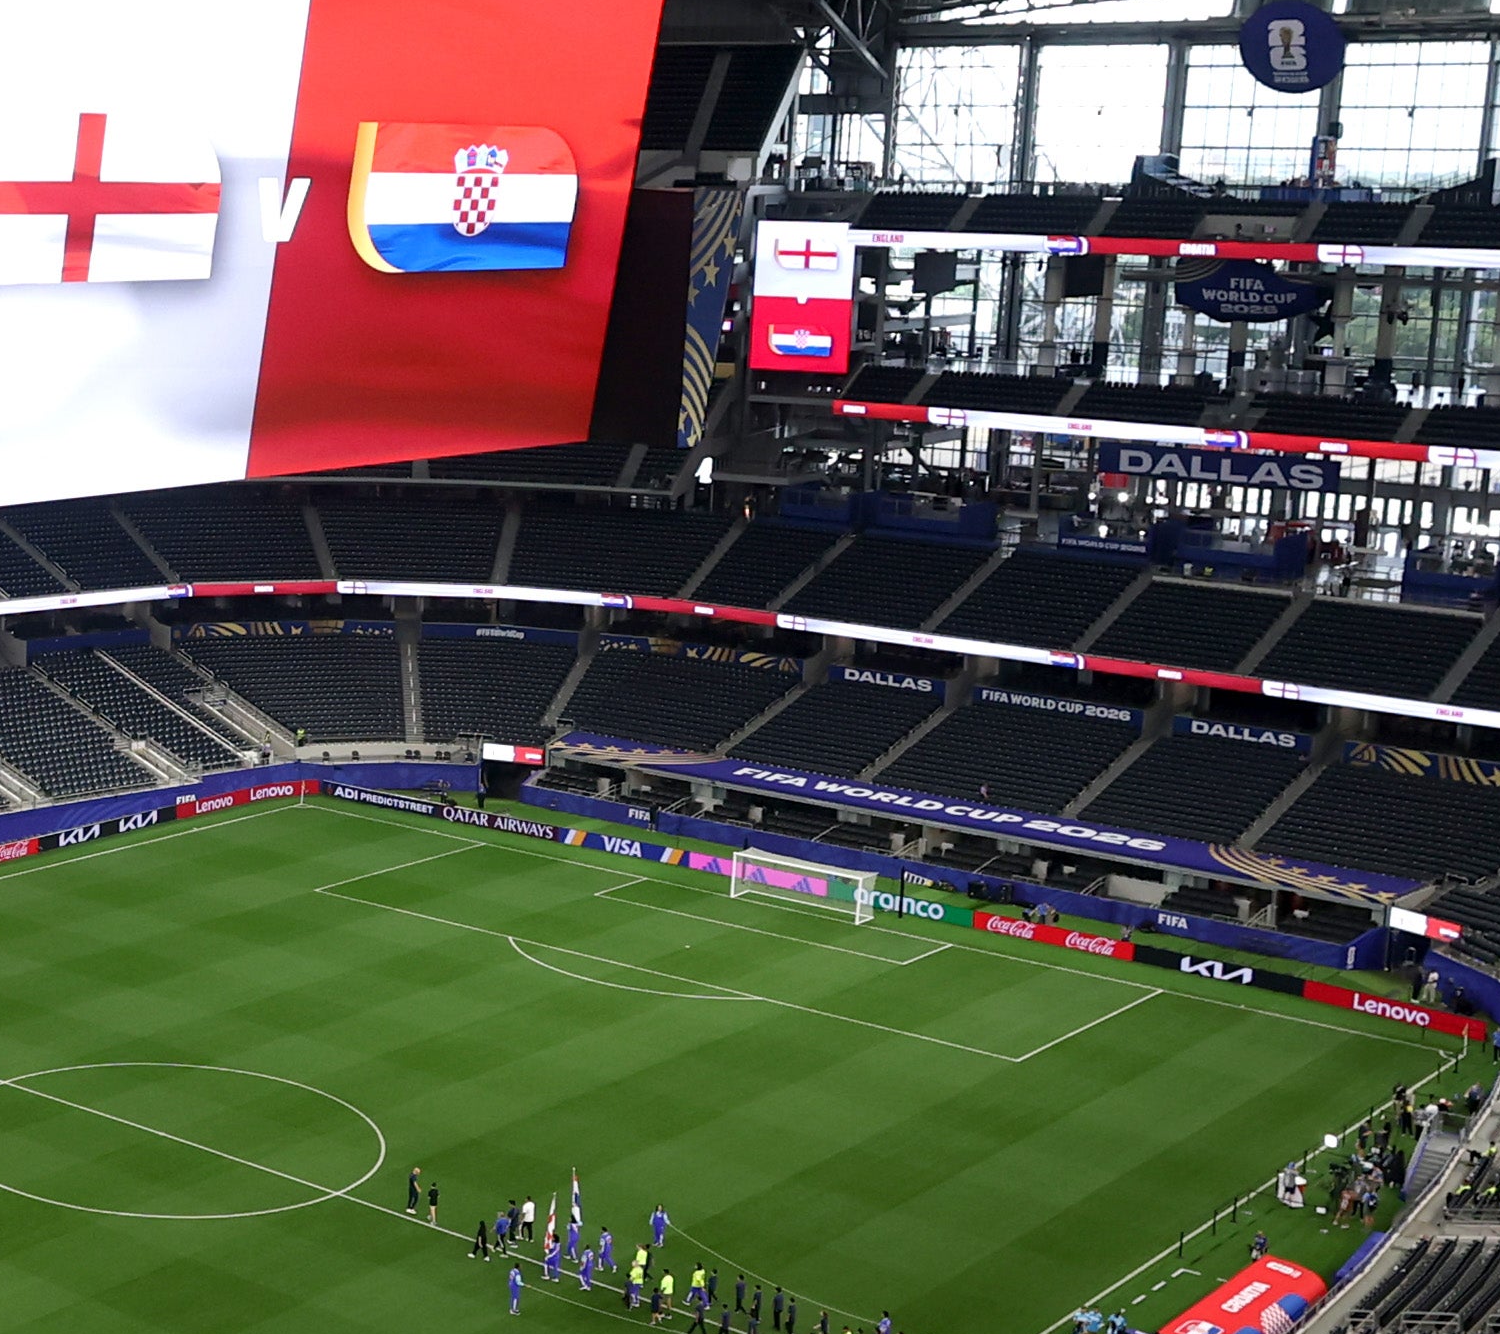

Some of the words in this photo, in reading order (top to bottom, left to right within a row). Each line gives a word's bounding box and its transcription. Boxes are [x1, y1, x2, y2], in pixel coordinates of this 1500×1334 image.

[1202, 289, 1258, 303] WORLD
[1262, 292, 1297, 304] CUP
[1230, 277, 1265, 292] FIFA
[1220, 302, 1278, 315] 2026
[1119, 449, 1324, 489] DALLAS
[843, 668, 932, 692] DALLAS
[981, 689, 1009, 705] FIFA
[1010, 693, 1057, 711] WORLD
[1057, 699, 1084, 716] CUP
[1085, 705, 1132, 722] 2026
[1191, 720, 1296, 748] DALLAS
[195, 795, 235, 815] Lenovo
[250, 784, 295, 802] Lenovo
[334, 786, 359, 801] ADI
[360, 792, 435, 815] PREDICTSTREET
[628, 808, 651, 822] FIFA
[733, 766, 806, 788] FIFA
[814, 780, 946, 812] WORLD
[944, 805, 1024, 824] CUP
[1021, 819, 1167, 852] 2026
[442, 805, 490, 829] QATAR
[494, 816, 555, 841] AIRWAYS
[601, 835, 643, 859] VISA
[1157, 913, 1189, 929] FIFA
[1353, 993, 1430, 1026] Lenovo
[1221, 1281, 1271, 1313] CROATIA
